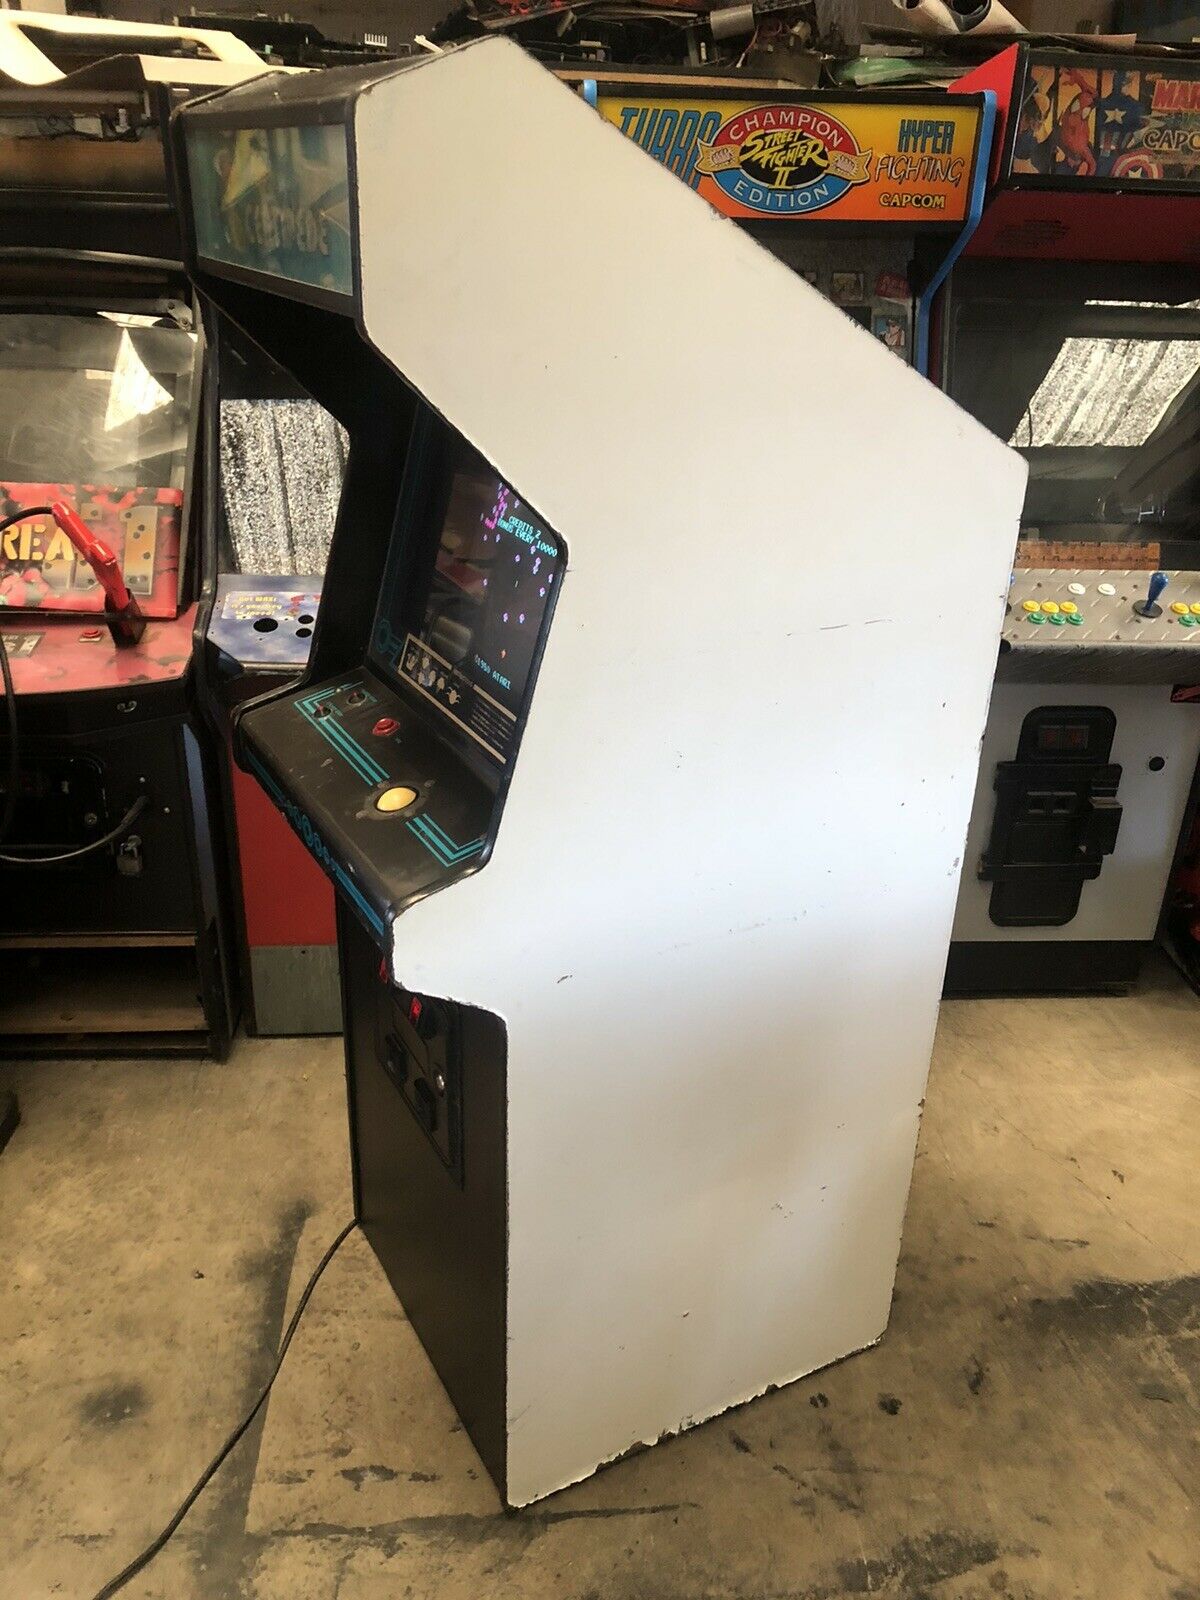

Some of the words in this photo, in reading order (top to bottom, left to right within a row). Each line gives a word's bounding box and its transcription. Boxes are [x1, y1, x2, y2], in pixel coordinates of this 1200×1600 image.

[729, 110, 844, 148] CHAMPION
[898, 119, 956, 154] HYPER
[740, 128, 803, 162] STREET
[752, 139, 830, 168] FIGHTER
[769, 166, 799, 190] II
[875, 155, 964, 187] FIGHTING
[733, 179, 829, 207] EDITION
[879, 192, 946, 209] CAPCOM
[508, 515, 534, 535] CREDITS
